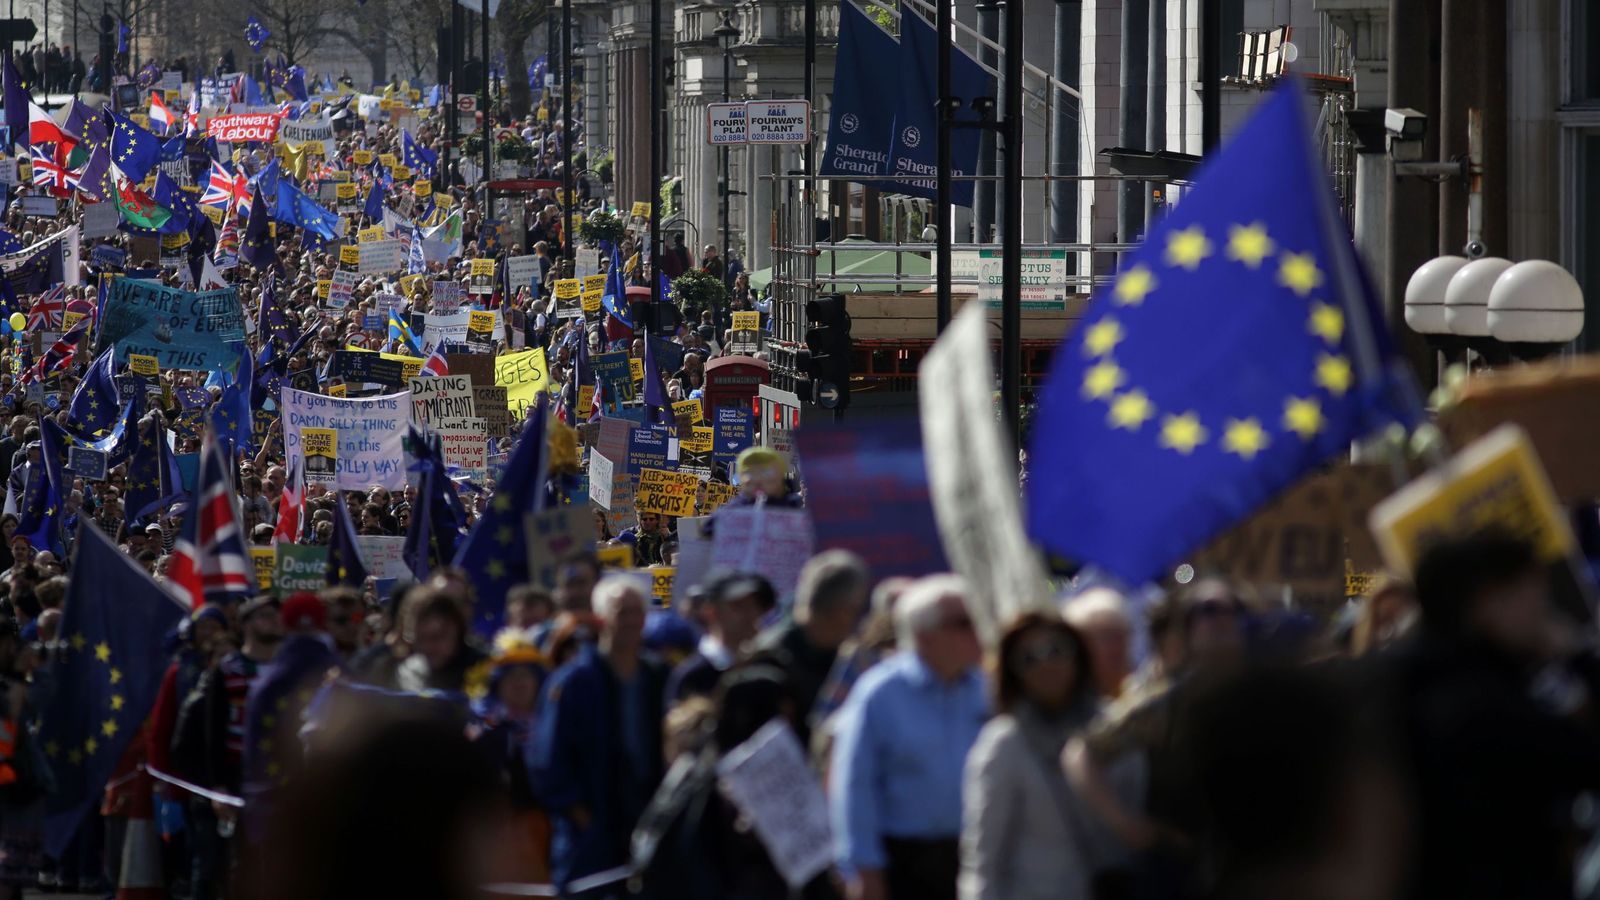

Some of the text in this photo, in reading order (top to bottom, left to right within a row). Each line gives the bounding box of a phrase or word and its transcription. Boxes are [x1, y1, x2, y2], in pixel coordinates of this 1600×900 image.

[210, 116, 275, 129] Southwark
[751, 117, 804, 125] FOURWAYS
[218, 128, 274, 140] Labour
[283, 124, 333, 139] CHELTENHAM
[835, 143, 888, 163] Sherato
[833, 157, 877, 174] Grand
[1020, 264, 1052, 273] CTUS
[988, 275, 1051, 285] SERITY
[113, 281, 142, 305] WE
[145, 286, 182, 313] ARE
[169, 315, 189, 330] OF
[167, 350, 207, 366] THIS
[412, 377, 466, 395] DATING
[292, 391, 397, 409] If you must do this
[436, 390, 448, 398] AN
[673, 404, 698, 414] MORE
[290, 412, 397, 430] DAMN SILLY THING
[445, 419, 467, 430] want
[472, 419, 487, 432] my
[692, 431, 712, 439] ORE
[359, 438, 380, 451] this
[374, 459, 399, 474] WAY
[643, 470, 659, 482] KEEP
[640, 482, 696, 496] FINGERS OFF OUR
[283, 556, 326, 574] Deviz
